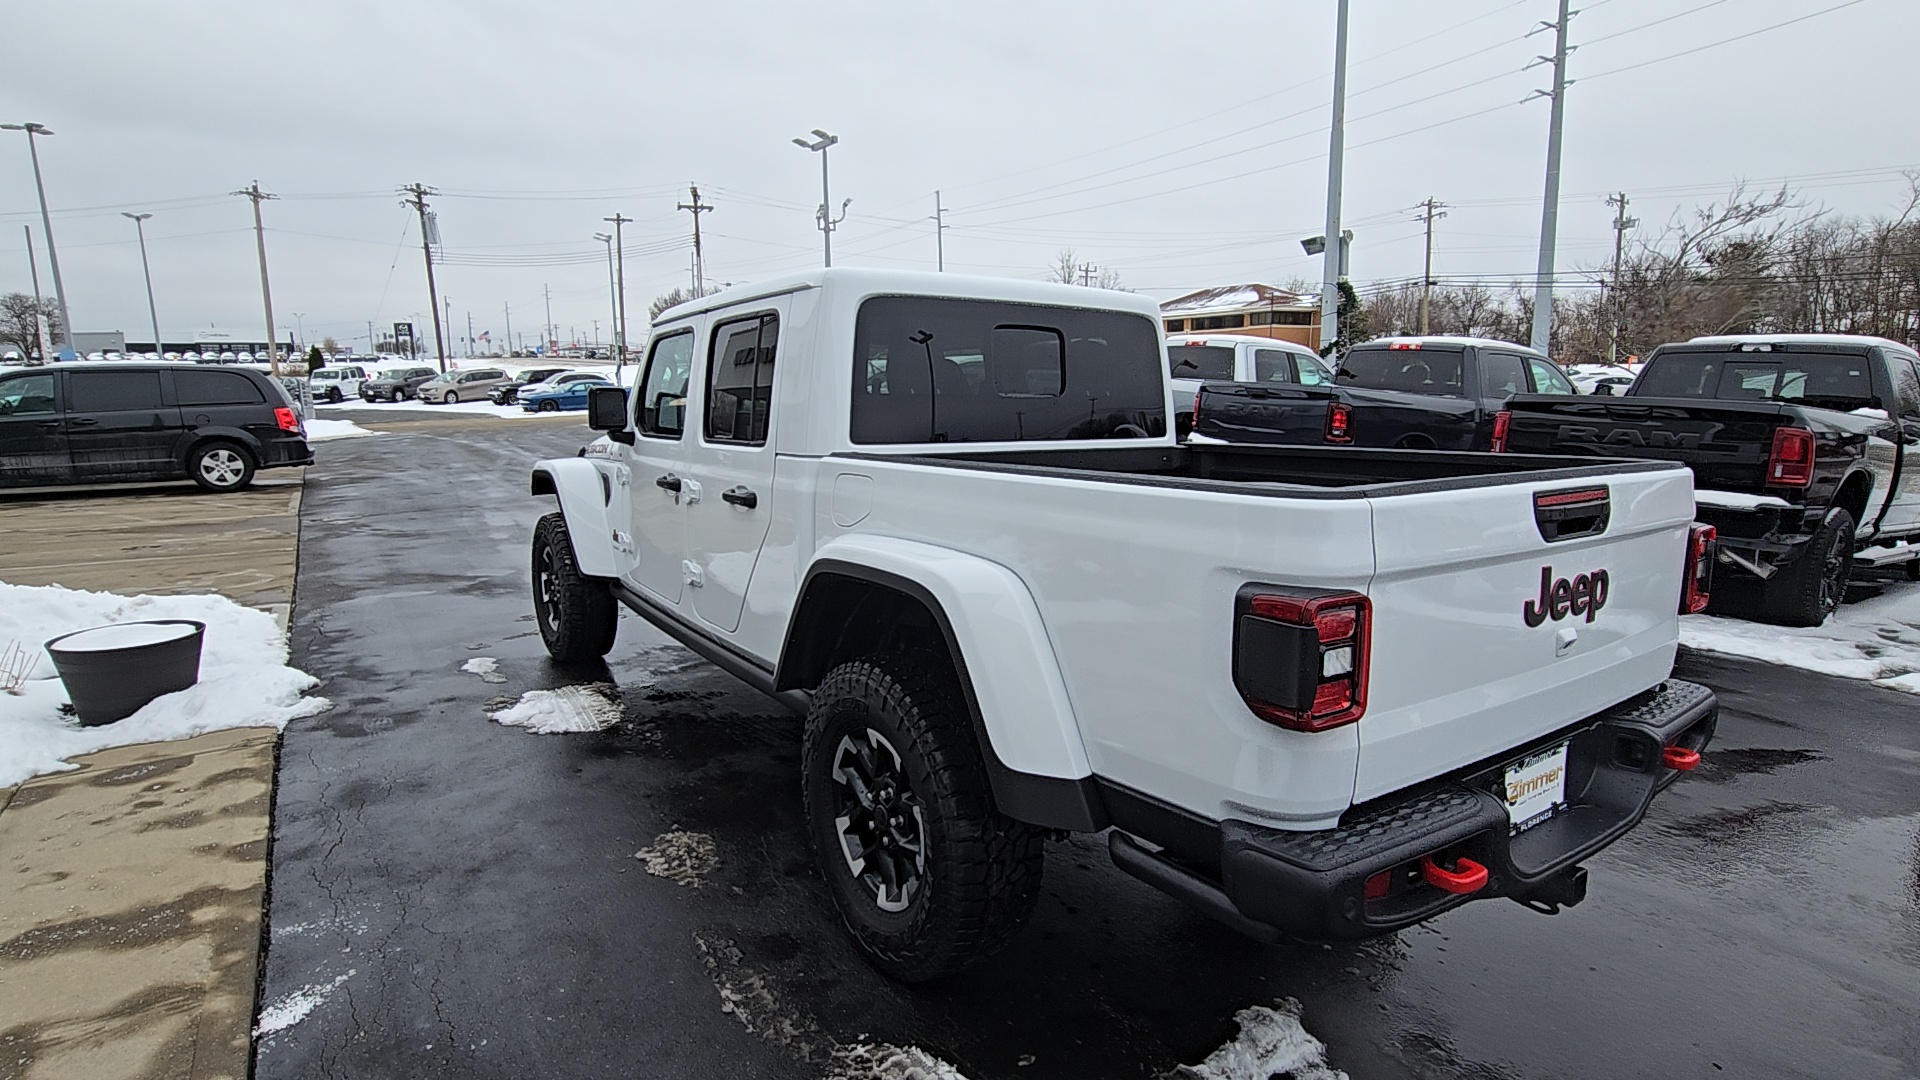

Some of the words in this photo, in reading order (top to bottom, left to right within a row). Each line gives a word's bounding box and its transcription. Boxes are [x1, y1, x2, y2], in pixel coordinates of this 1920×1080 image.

[1223, 402, 1294, 419] RAM
[1557, 424, 1701, 449] RAM
[1523, 565, 1610, 628] Jeep
[1507, 766, 1563, 803] Zimmer
